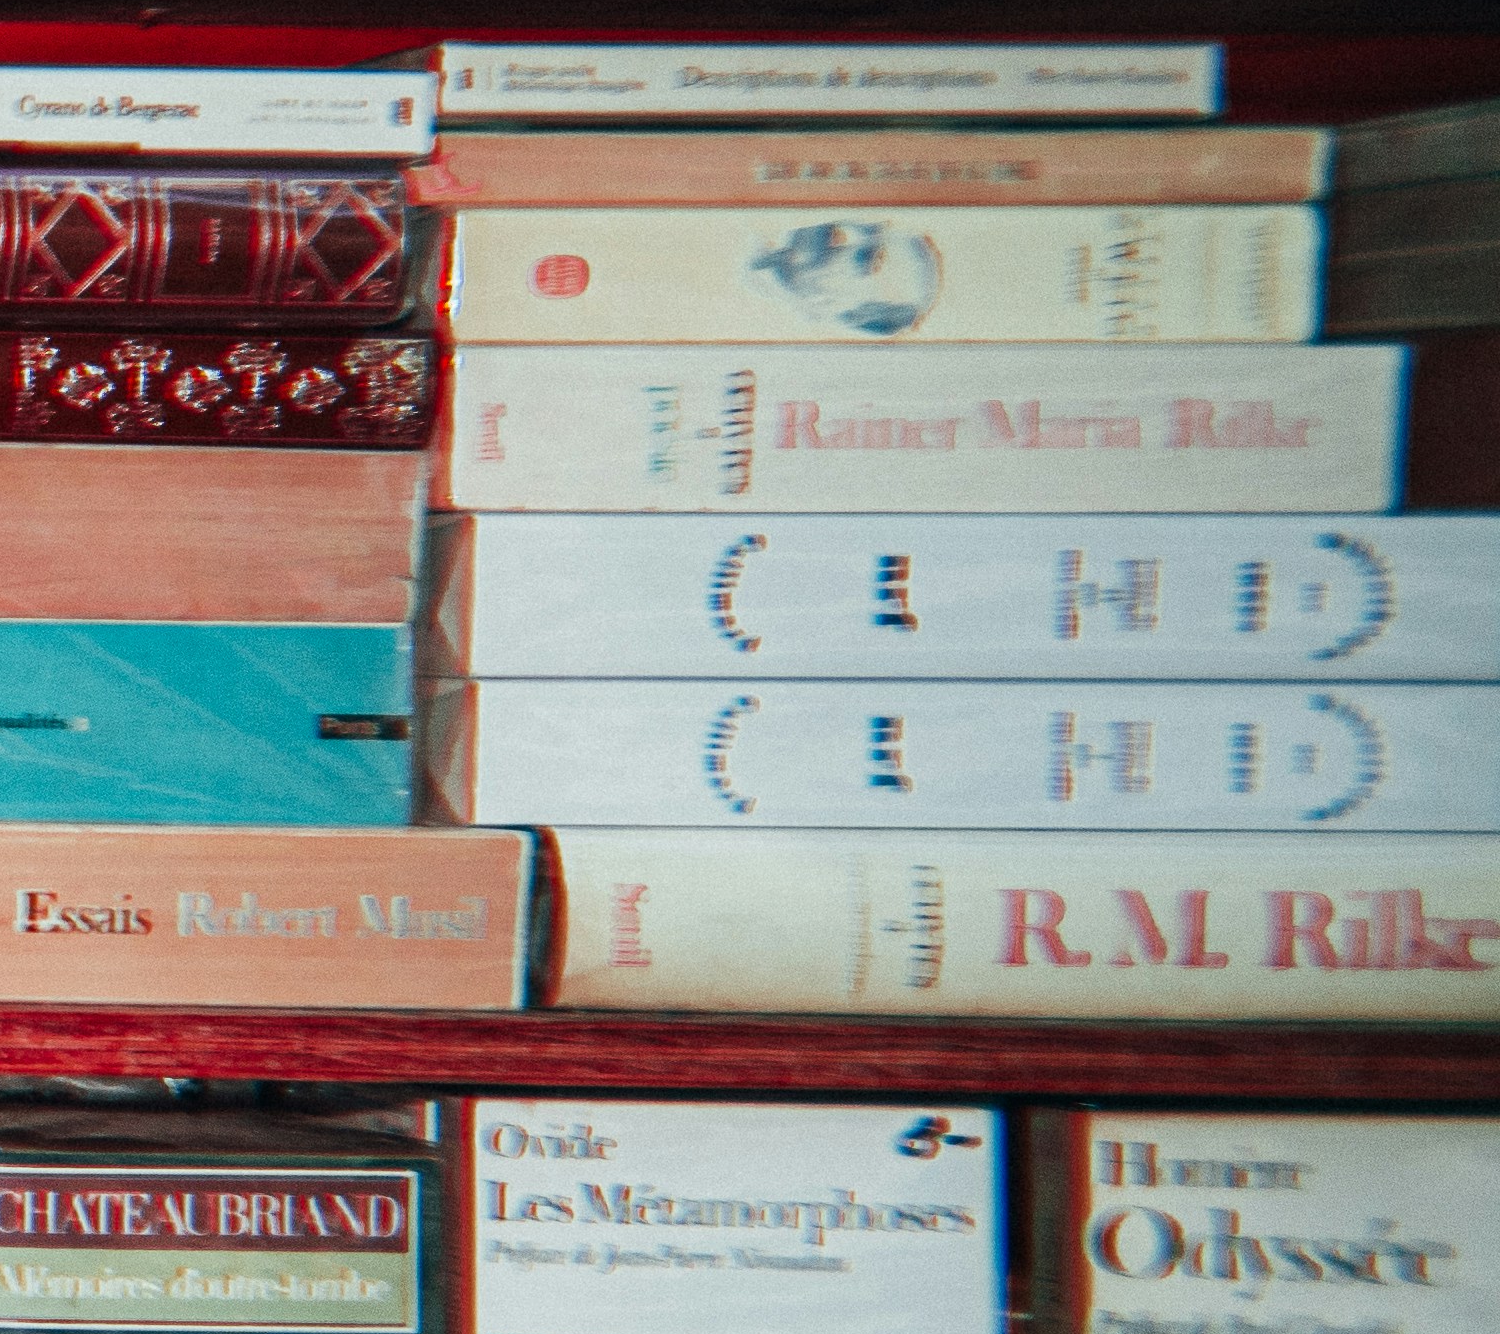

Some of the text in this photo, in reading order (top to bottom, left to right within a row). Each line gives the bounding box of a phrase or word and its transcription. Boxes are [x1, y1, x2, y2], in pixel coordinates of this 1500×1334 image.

[773, 396, 1326, 452] Rainer Maria Rilke
[15, 888, 154, 937] Essais
[176, 891, 340, 939] Robert
[482, 1121, 619, 1164] Ovide
[483, 1178, 978, 1246] Les Métamorphoses
